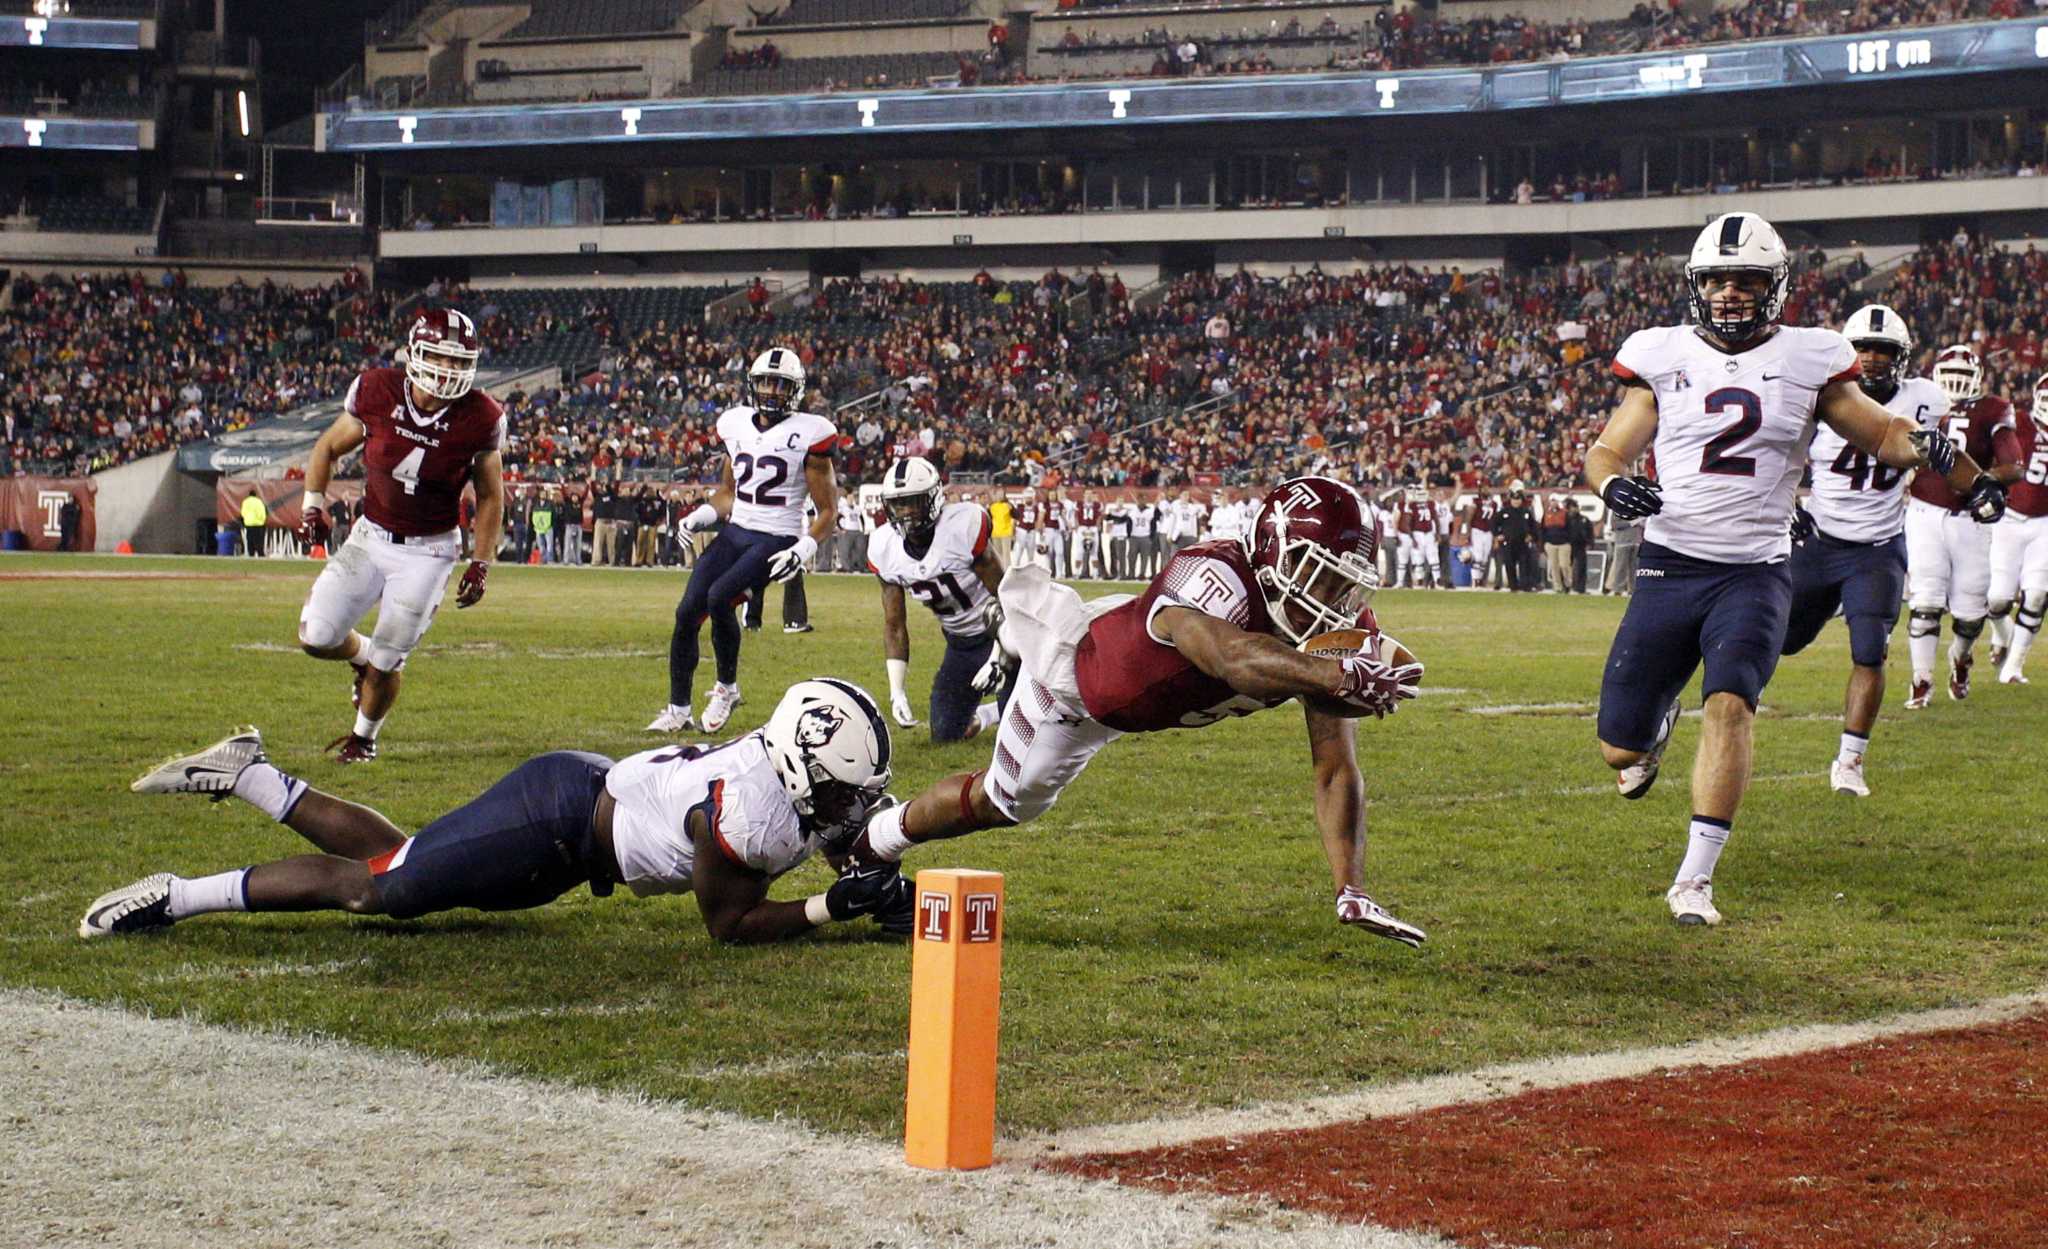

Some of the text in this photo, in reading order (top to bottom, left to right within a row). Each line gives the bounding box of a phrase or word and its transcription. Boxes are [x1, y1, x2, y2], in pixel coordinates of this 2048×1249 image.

[1846, 39, 1931, 74] 1ST QTR
[1108, 89, 1131, 118] T
[1375, 78, 1399, 109] T
[398, 116, 417, 144] T
[621, 107, 641, 136] T
[857, 98, 879, 127] T
[1699, 386, 1762, 477] 2
[1916, 404, 1929, 425] C
[395, 425, 440, 448] TEMPLE
[787, 432, 801, 449] C
[391, 446, 426, 495] 4
[733, 452, 788, 506] 22
[38, 490, 69, 537] T
[911, 572, 973, 616] 21
[1188, 567, 1234, 611] T
[921, 891, 950, 940] T
[966, 893, 997, 942] T
